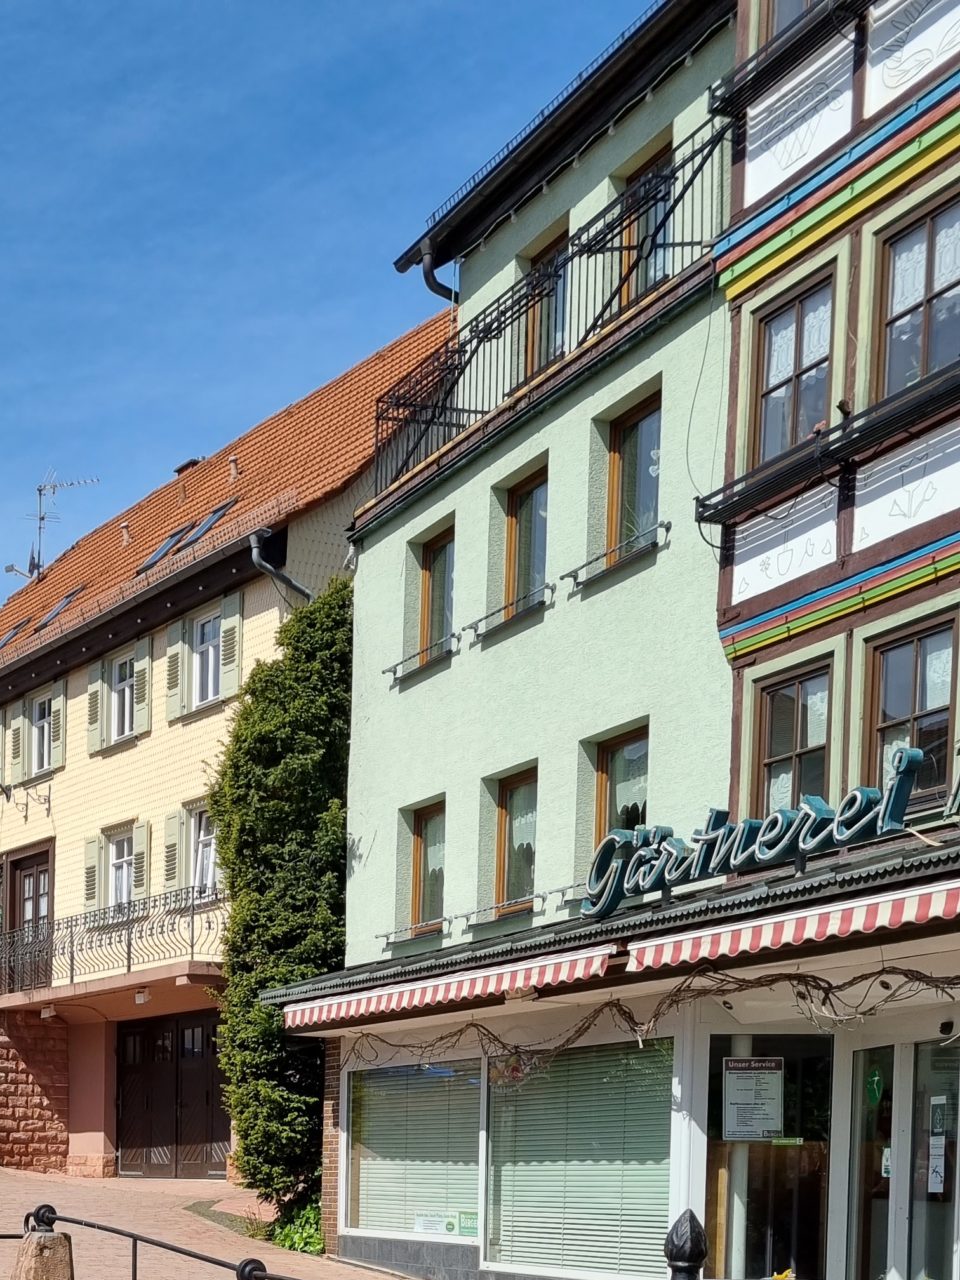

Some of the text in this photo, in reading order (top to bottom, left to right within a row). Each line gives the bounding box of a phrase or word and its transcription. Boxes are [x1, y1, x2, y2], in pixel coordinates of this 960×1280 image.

[580, 747, 924, 918] Gärtnerei
[728, 1060, 776, 1068] Unser Service
